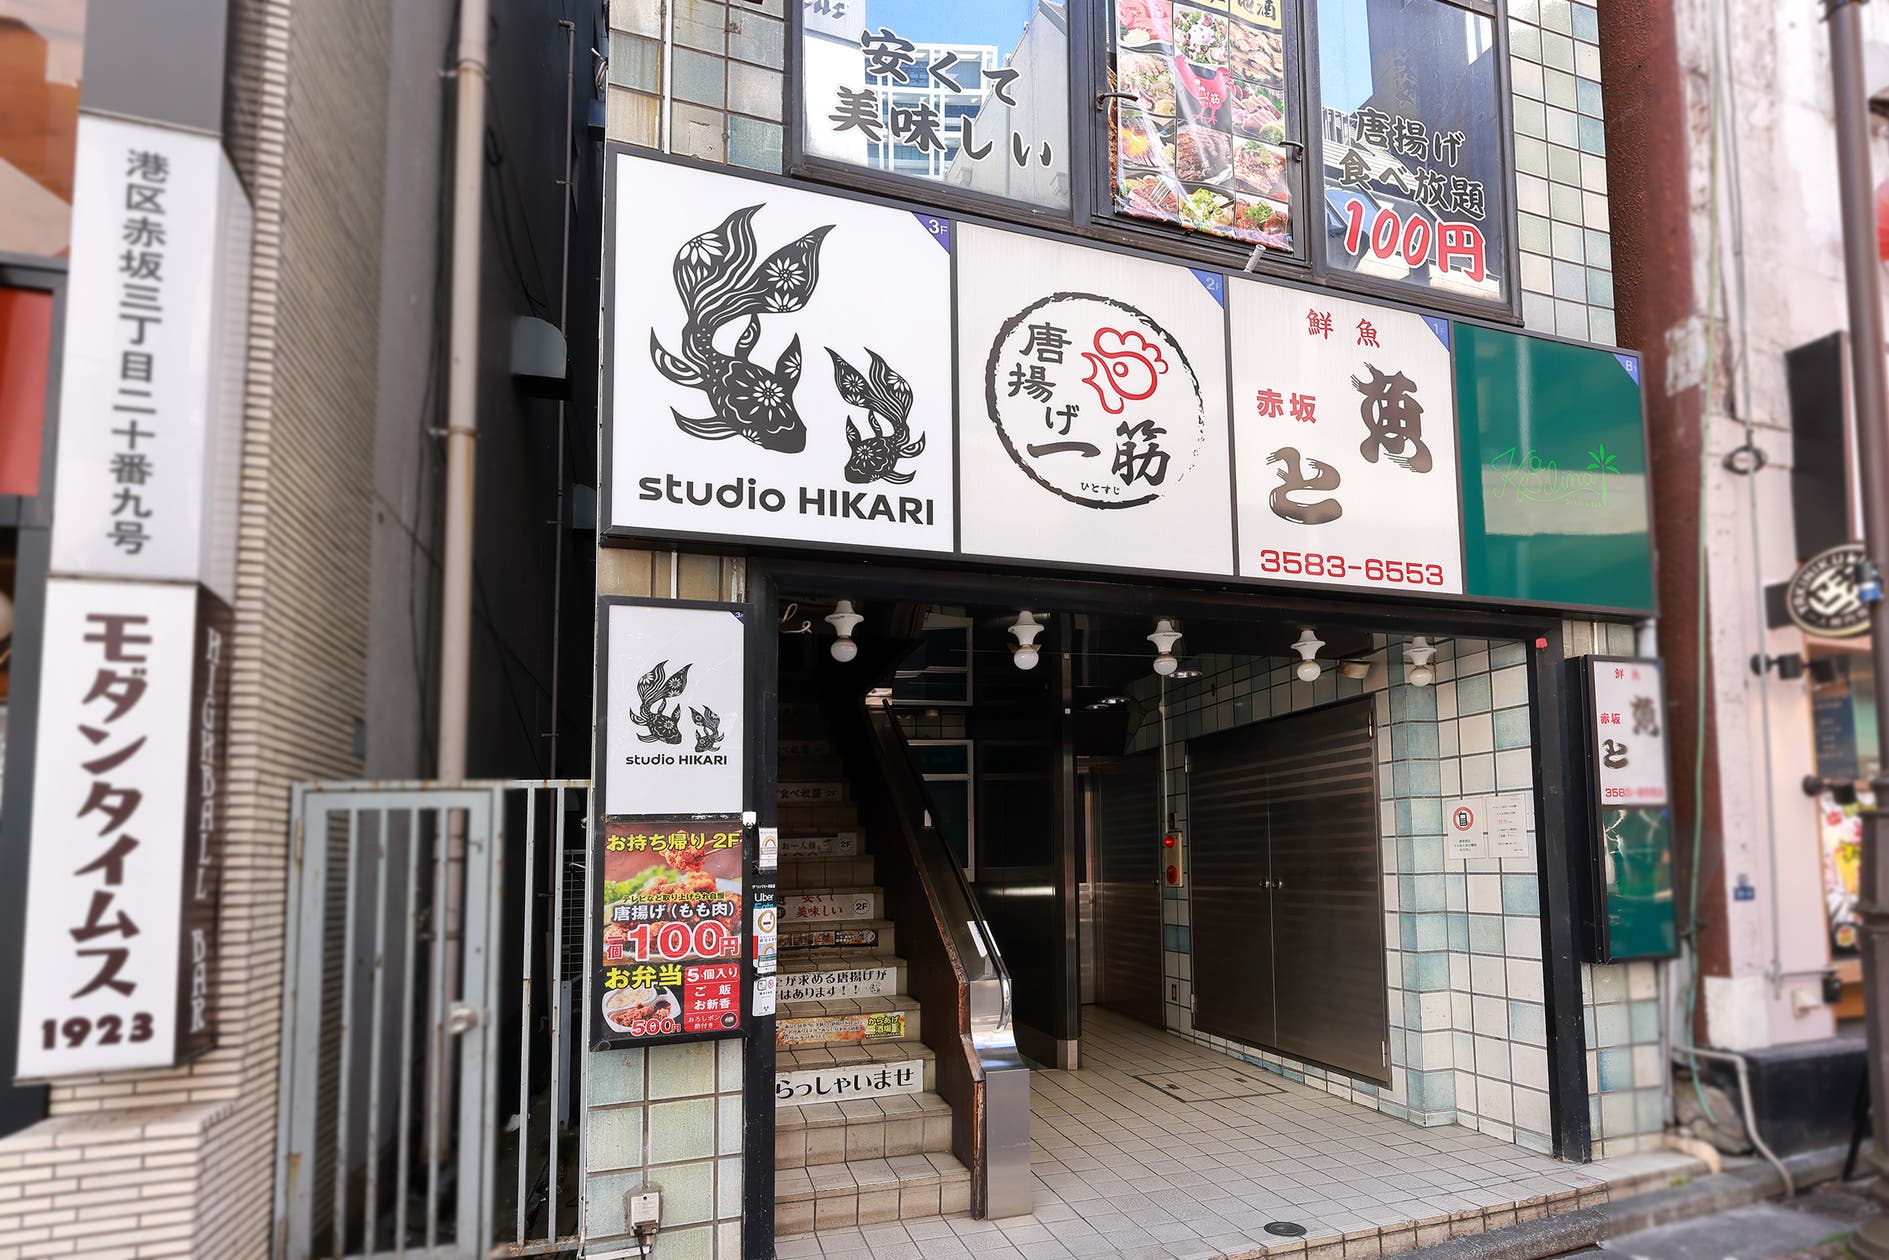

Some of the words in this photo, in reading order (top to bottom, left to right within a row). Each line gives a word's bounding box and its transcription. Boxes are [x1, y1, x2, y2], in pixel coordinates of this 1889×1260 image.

[861, 28, 1020, 107] 安くて
[828, 85, 1052, 168] 美味しい
[1355, 106, 1466, 168] 唐揚げ
[1338, 147, 1486, 221] 食べ放題
[928, 218, 948, 236] 3F
[1344, 198, 1487, 284] 100円
[1306, 308, 1380, 348] 鮮魚
[107, 149, 169, 556] 港区赤坂三丁目二十番九号
[1007, 322, 1080, 435] 唐揚げ
[1256, 388, 1317, 424] 赤坂
[1026, 419, 1171, 487] 一筋
[638, 473, 787, 513] studio
[799, 486, 934, 527] HIKARI
[1081, 481, 1121, 496] ひとすじ
[1260, 549, 1444, 586] 3583-6553
[625, 753, 675, 766] studio
[678, 754, 728, 766] HIKARI
[69, 613, 153, 1000] モダンタイムス
[606, 833, 705, 852] お持ち帰り
[712, 832, 741, 850] 2F
[754, 892, 774, 902] Uber
[796, 905, 844, 919] 美味しい
[854, 902, 868, 912] 2F
[627, 920, 740, 962] 100円
[604, 963, 683, 990] お弁当
[686, 967, 738, 984] 5個入り
[694, 998, 731, 1011] お新香
[41, 1013, 155, 1051] 1923
[631, 1017, 682, 1036] 500円
[776, 1067, 915, 1100] らっしゃいませ
